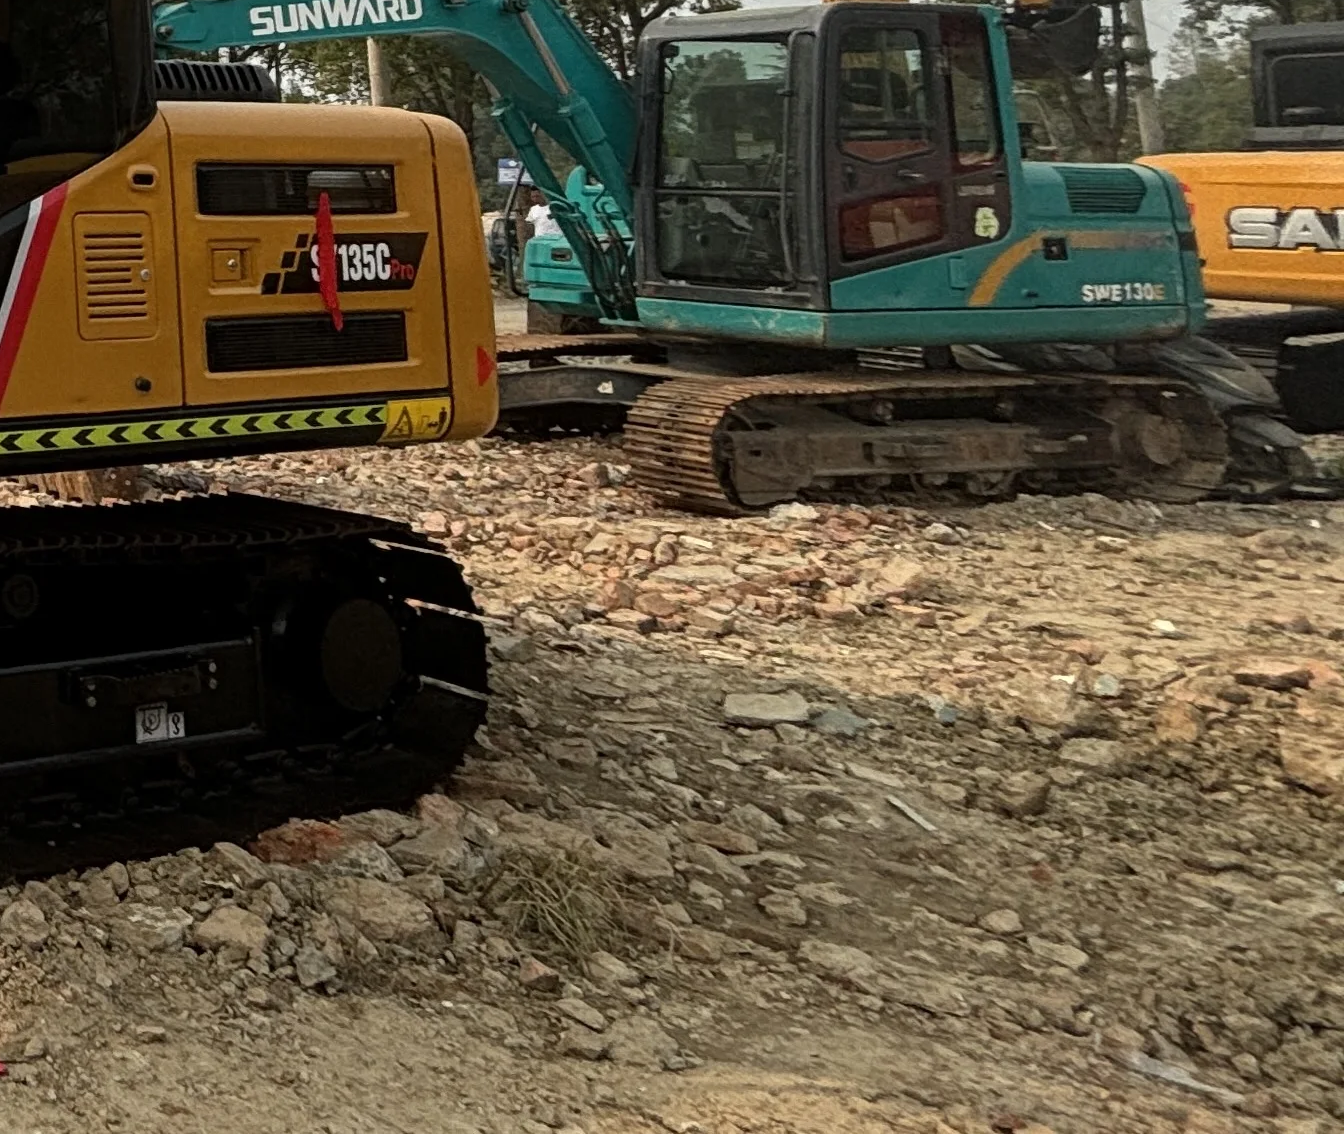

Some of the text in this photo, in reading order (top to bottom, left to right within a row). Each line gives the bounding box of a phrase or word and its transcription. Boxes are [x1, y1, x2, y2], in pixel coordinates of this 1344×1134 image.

[1228, 207, 1344, 250] SA
[310, 242, 415, 282] S135C Pro
